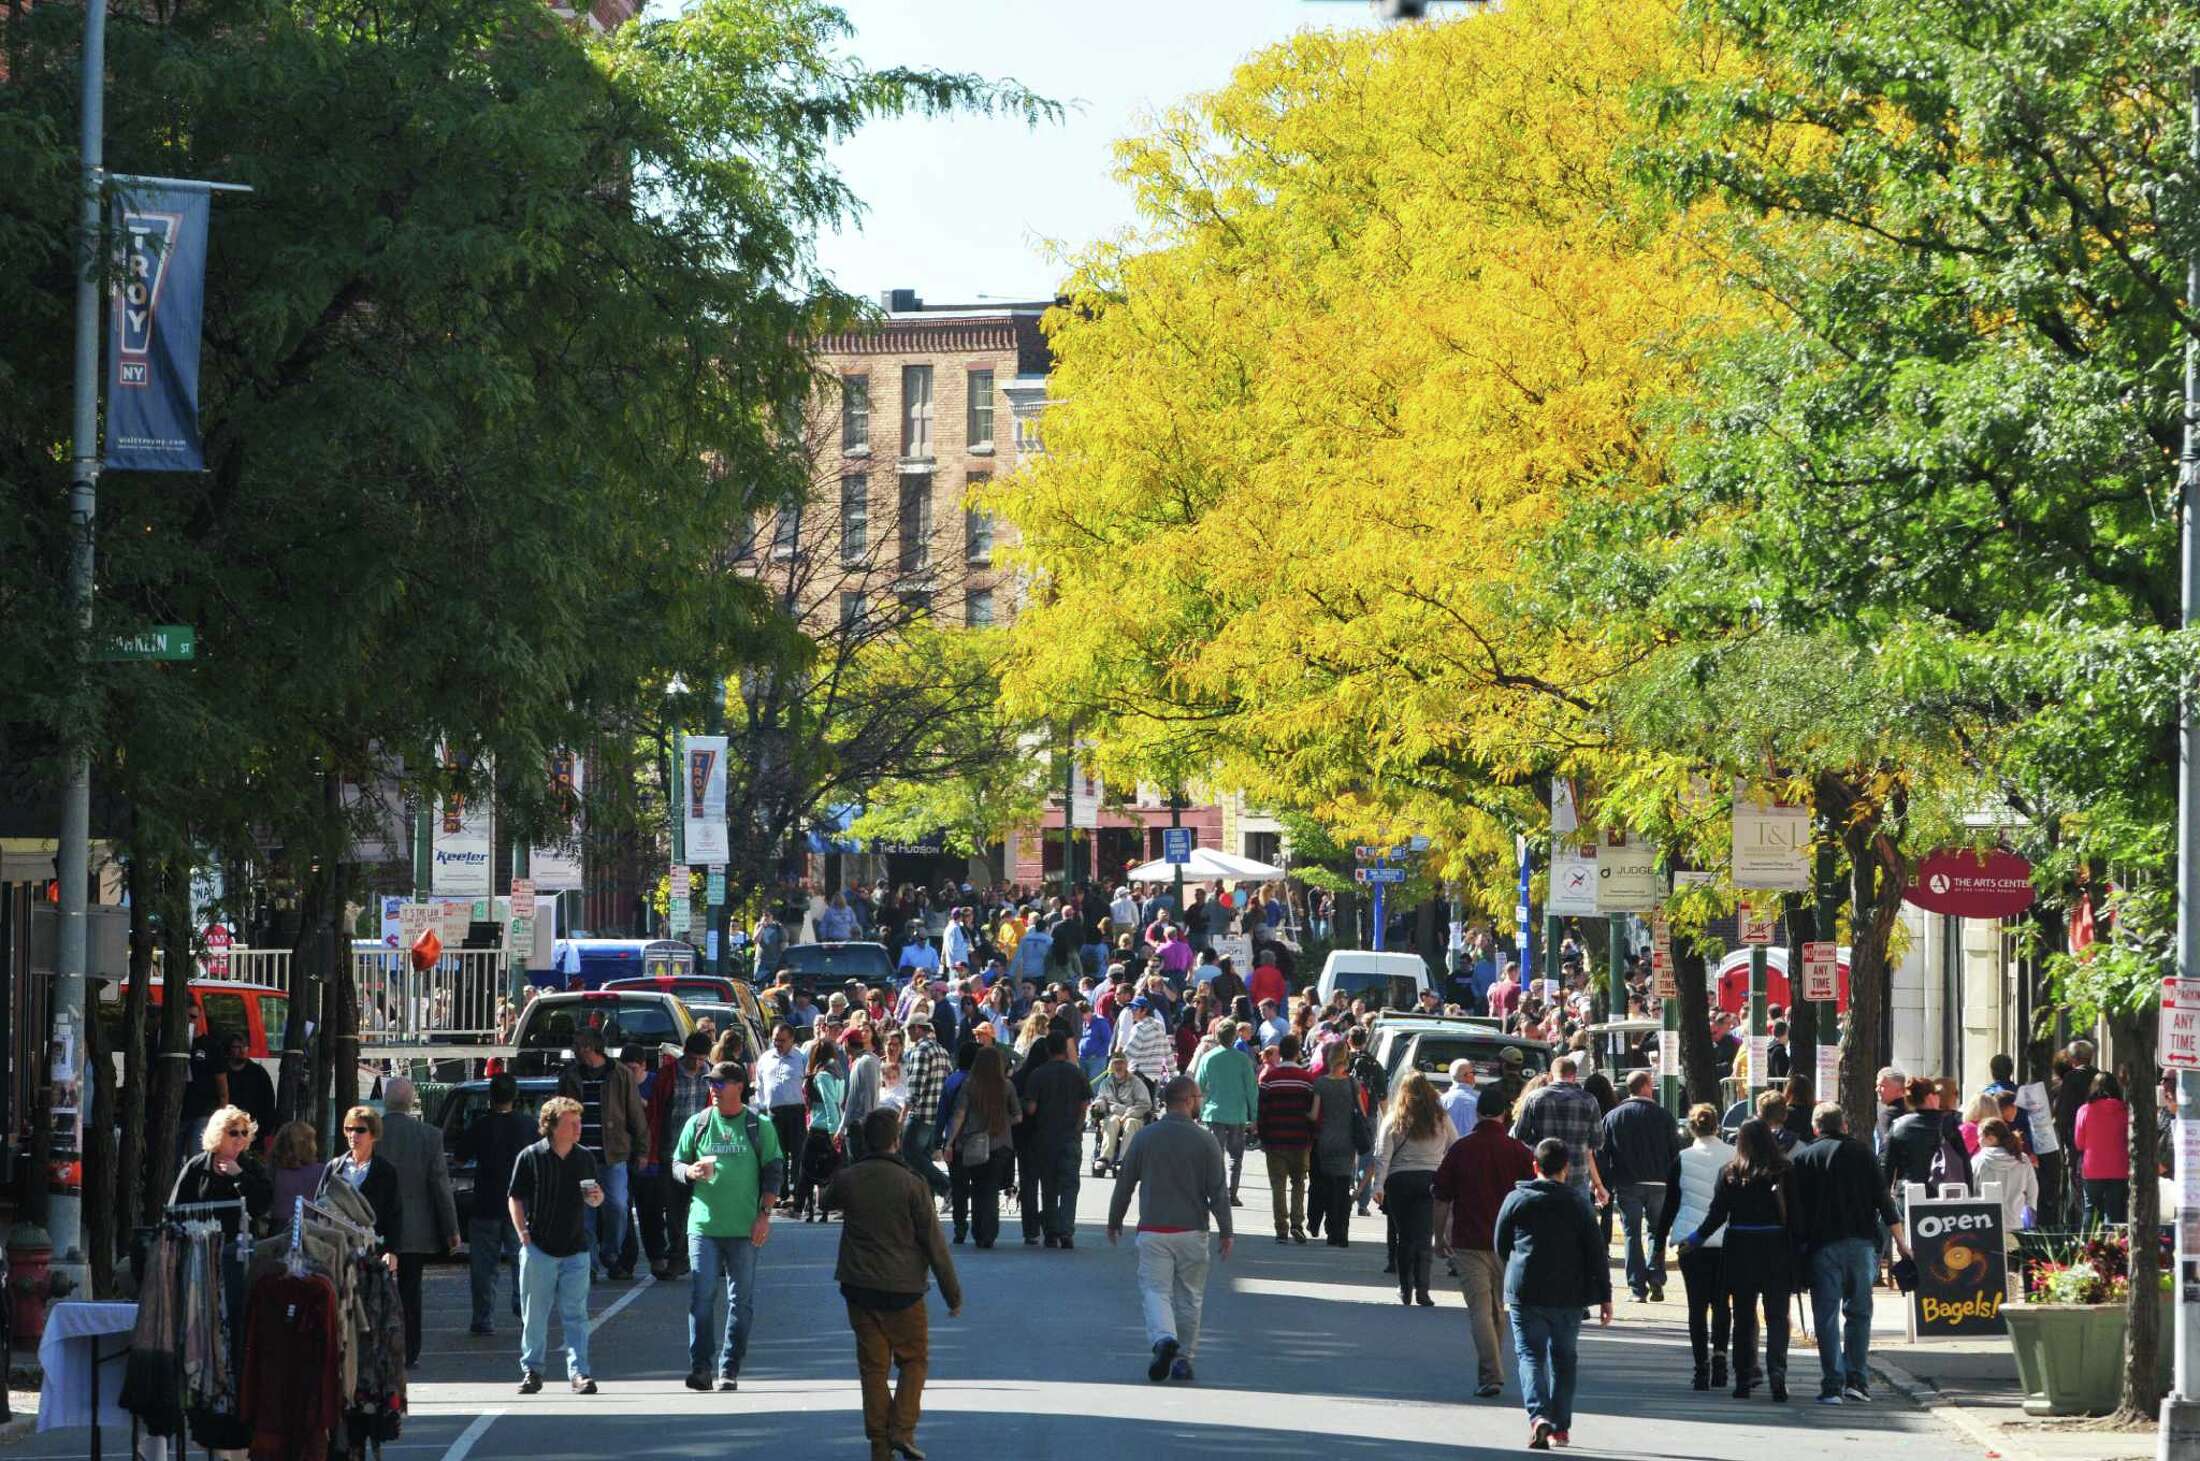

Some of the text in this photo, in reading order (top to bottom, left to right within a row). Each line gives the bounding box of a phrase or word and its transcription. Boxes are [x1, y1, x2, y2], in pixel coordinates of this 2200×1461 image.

[127, 226, 151, 333] TROY
[122, 366, 144, 381] NY
[179, 642, 190, 654] ST
[898, 842, 940, 854] HUDSON
[436, 850, 488, 865] Keeler
[1953, 878, 2030, 889] THE ARTS CENTE
[1804, 946, 1814, 959] NO
[1814, 965, 1828, 976] ANY
[1660, 980, 1676, 990] TIME
[1812, 978, 1830, 989] TIME
[2174, 1013, 2196, 1030] ANY
[2170, 1033, 2196, 1051] TIME
[1921, 1290, 2003, 1325] Bagels!
